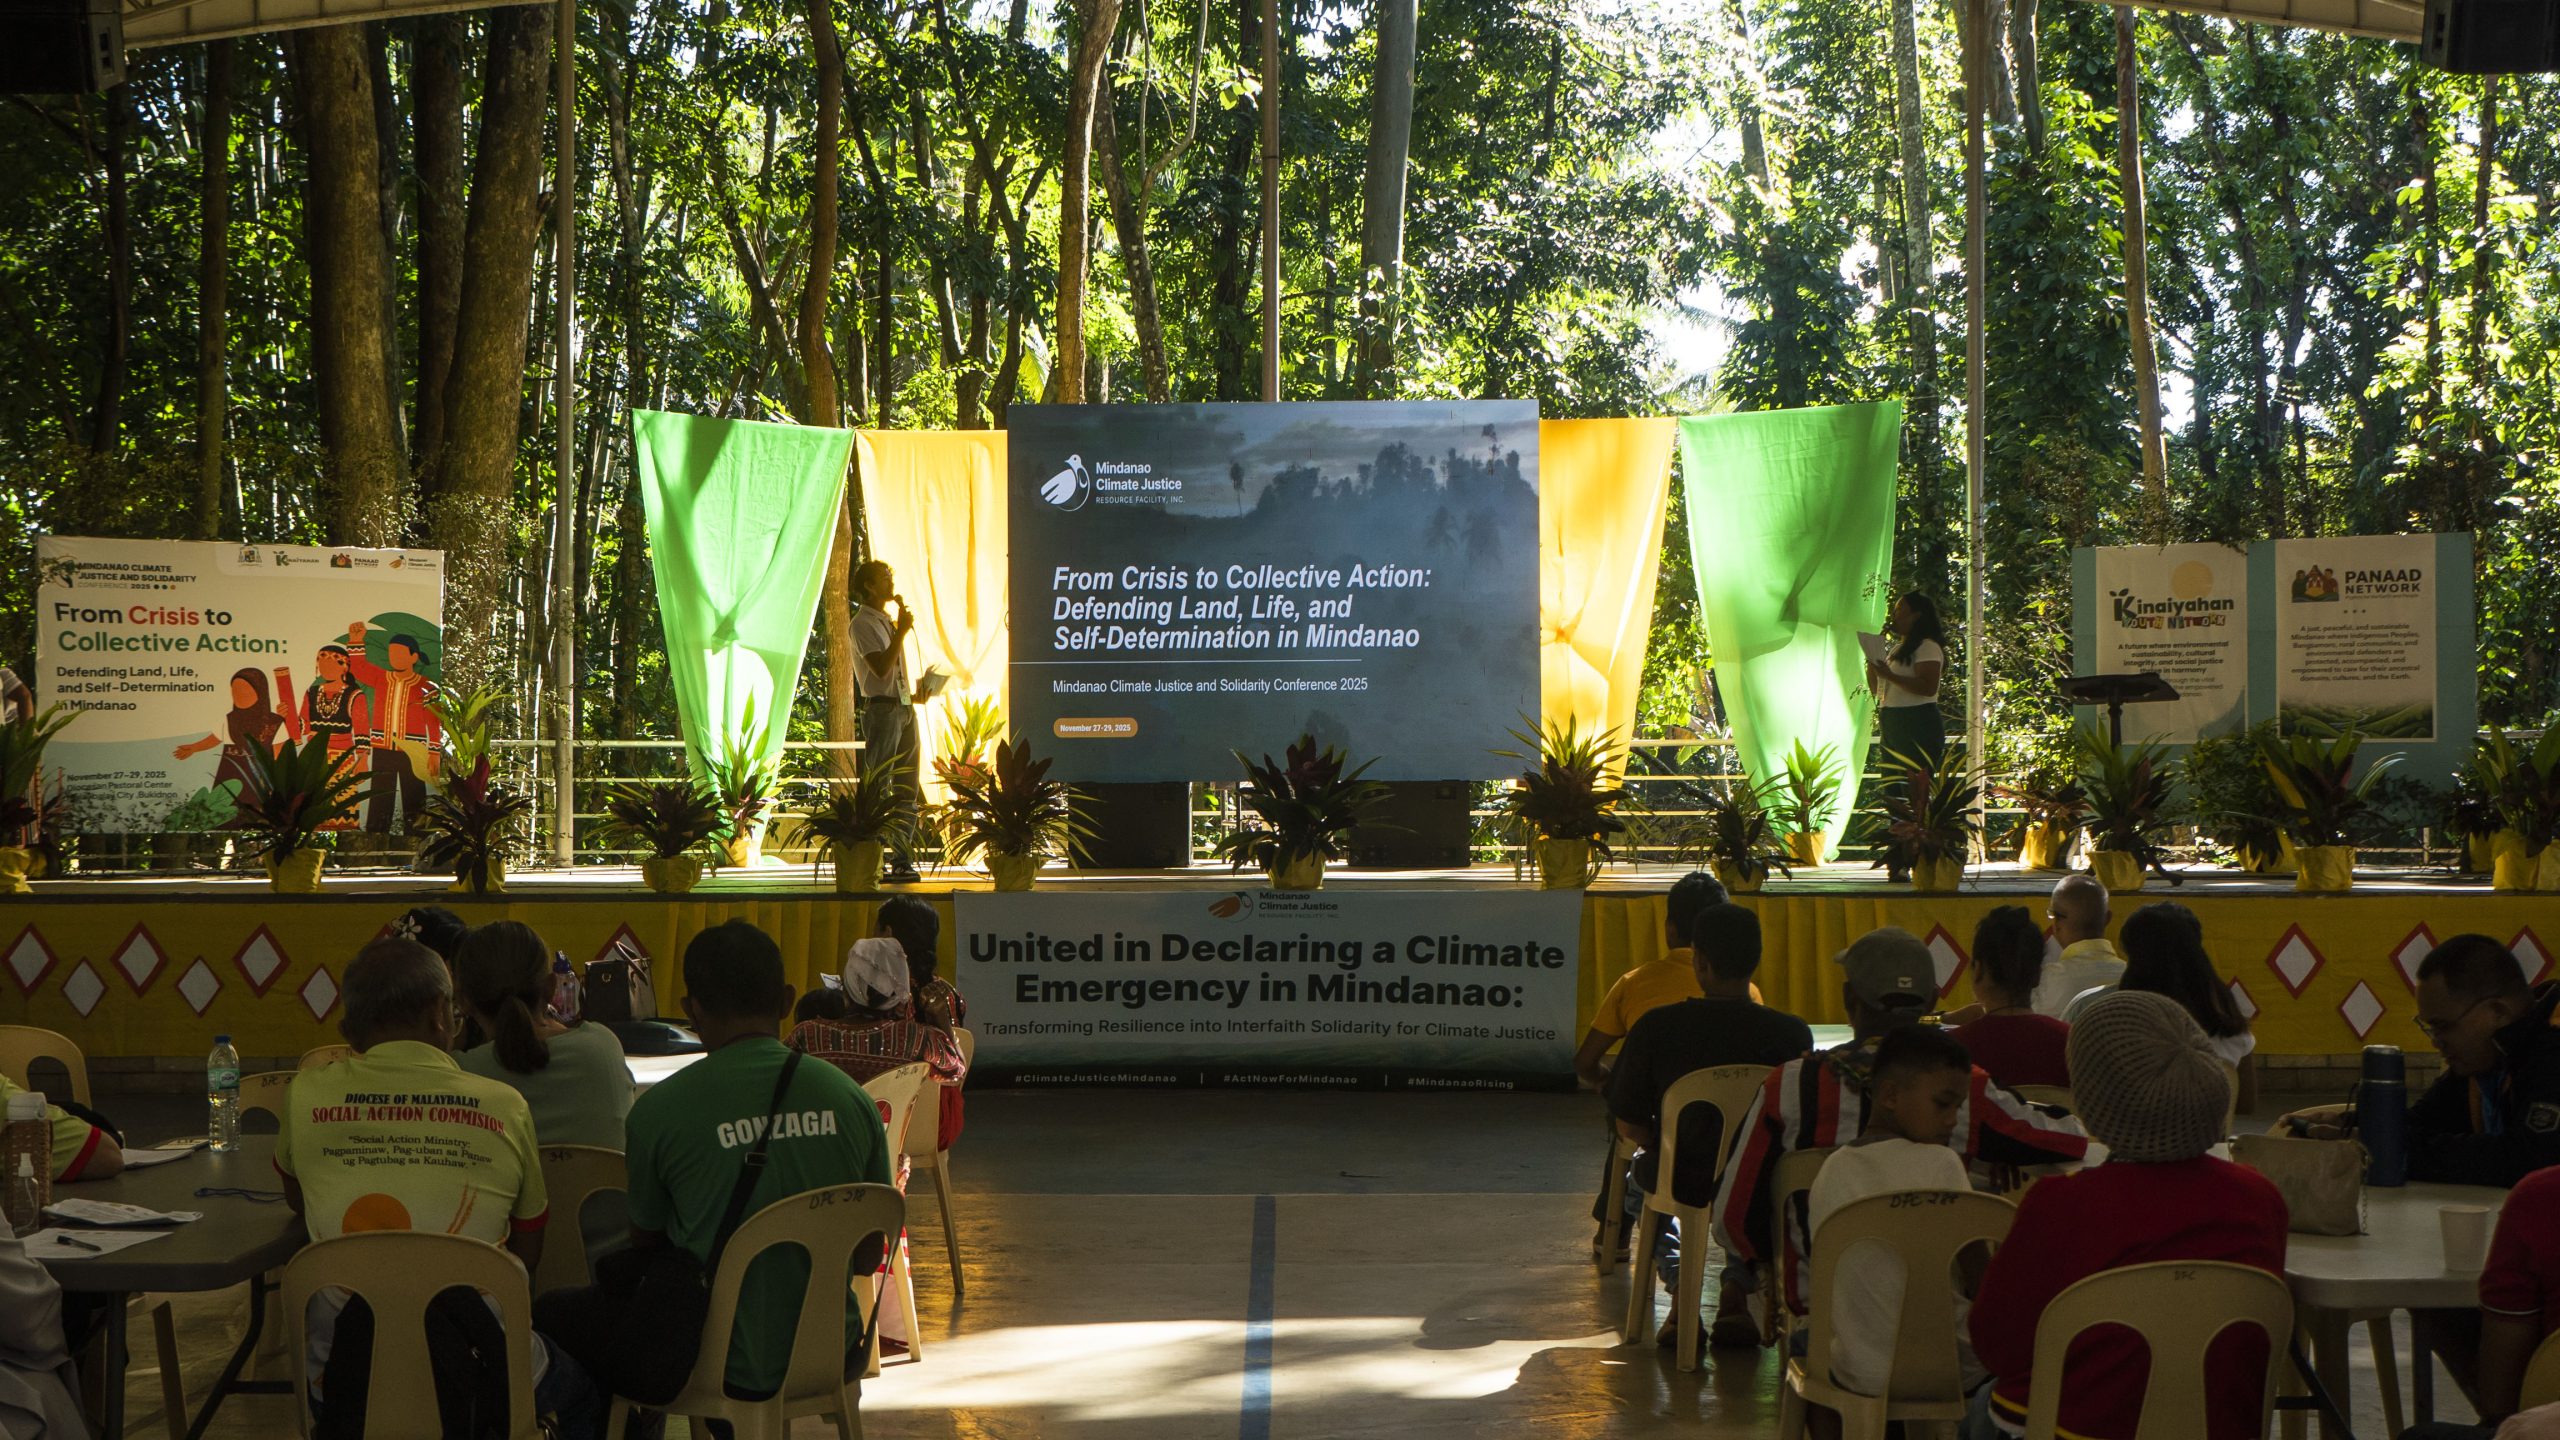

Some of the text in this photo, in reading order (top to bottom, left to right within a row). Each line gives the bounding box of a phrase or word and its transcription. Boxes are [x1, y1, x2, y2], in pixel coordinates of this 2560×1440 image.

[1096, 461, 1151, 474] Mindanao
[1096, 478, 1182, 491] Climate Justice
[1096, 496, 1133, 504] RESOURCE
[79, 562, 172, 573] MINDANAO CLIMATE
[79, 572, 197, 583] JUSTICE AND SOLIDARITY
[1053, 563, 1431, 591] From Crisis to Collective Action:
[2345, 569, 2422, 584] PANAAD
[2345, 583, 2421, 595] NETWORK
[55, 602, 232, 625] From Crisis to
[1053, 594, 1353, 626] Defending Land, Life, and
[2113, 595, 2234, 621] Kinaiyahan
[58, 631, 287, 654] Collective Action:
[1053, 623, 1420, 650] Self-Determination in Mindanao
[2124, 642, 2147, 650] future
[2173, 641, 2229, 649] environmental
[2198, 658, 2224, 667] justice
[57, 666, 199, 679] Defending Land, Life,
[57, 682, 214, 694] and Self-Determination
[1053, 677, 1368, 695] Mindanao Climate Justice and Solidarity Conference 2025
[70, 700, 137, 711] Mindanao
[1060, 724, 1092, 732] November
[1115, 724, 1131, 732] 2025
[67, 773, 112, 781] November
[108, 781, 143, 789] Pastoral
[144, 780, 173, 788] Center
[1259, 892, 1310, 900] Mindanao
[1259, 902, 1338, 911] Climate Justice
[969, 932, 1565, 971] United in Declaring a Climate
[1016, 972, 1523, 1009] Emergency in Mindanao:
[983, 1018, 1556, 1041] Transforming Resilience into Interfaith Solidarity for Climate Justice
[1015, 1072, 1514, 1090] #ClimateJusticeMindanao #ActNowForMindanao #MindanaoRising
[344, 1093, 481, 1109] DIOCESE OF MALAYBALAY
[312, 1106, 361, 1124] SOCIAL
[367, 1106, 424, 1122] ACTION
[717, 1109, 837, 1149] GONZAGA
[387, 1135, 421, 1144] Action
[424, 1136, 470, 1148] Ministry:
[343, 1158, 356, 1167] ug
[358, 1155, 406, 1166] Pagtubag
[408, 1157, 420, 1165] sa
[393, 1146, 443, 1156] Pag-uban
[446, 1149, 458, 1157] sa
[461, 1150, 493, 1163] Panaw
